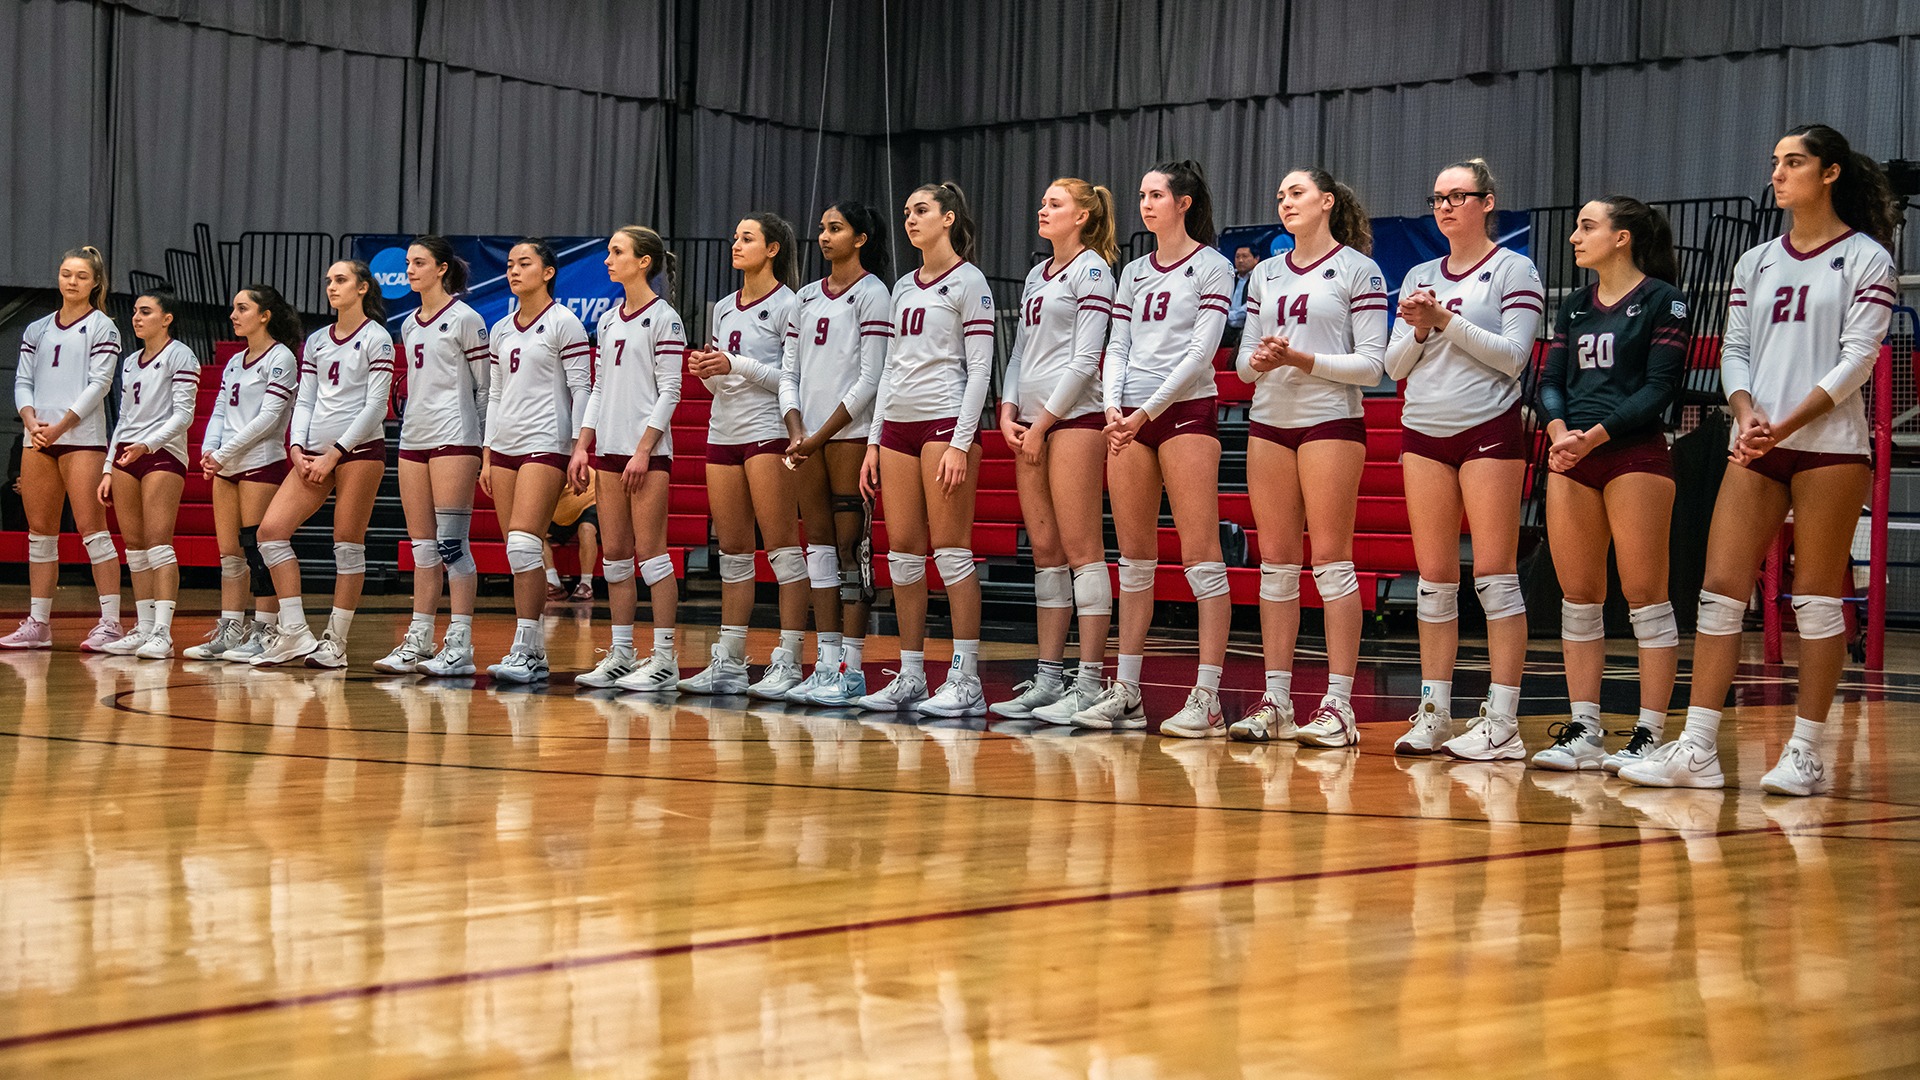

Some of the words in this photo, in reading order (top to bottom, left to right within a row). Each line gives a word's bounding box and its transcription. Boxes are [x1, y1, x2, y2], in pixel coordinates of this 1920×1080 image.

[1025, 296, 1043, 327] 12
[1141, 292, 1171, 322] 13
[1277, 293, 1309, 327] 14
[1771, 285, 1810, 324] 21
[814, 317, 830, 346] 9
[901, 307, 926, 336] 10
[52, 344, 61, 367] 1
[614, 339, 627, 366] 7
[728, 330, 742, 354] 8
[1578, 333, 1615, 370] 20
[414, 343, 425, 369] 5
[510, 347, 521, 373] 6
[328, 361, 340, 386] 4
[132, 381, 141, 405] 2
[229, 382, 240, 407] 3
